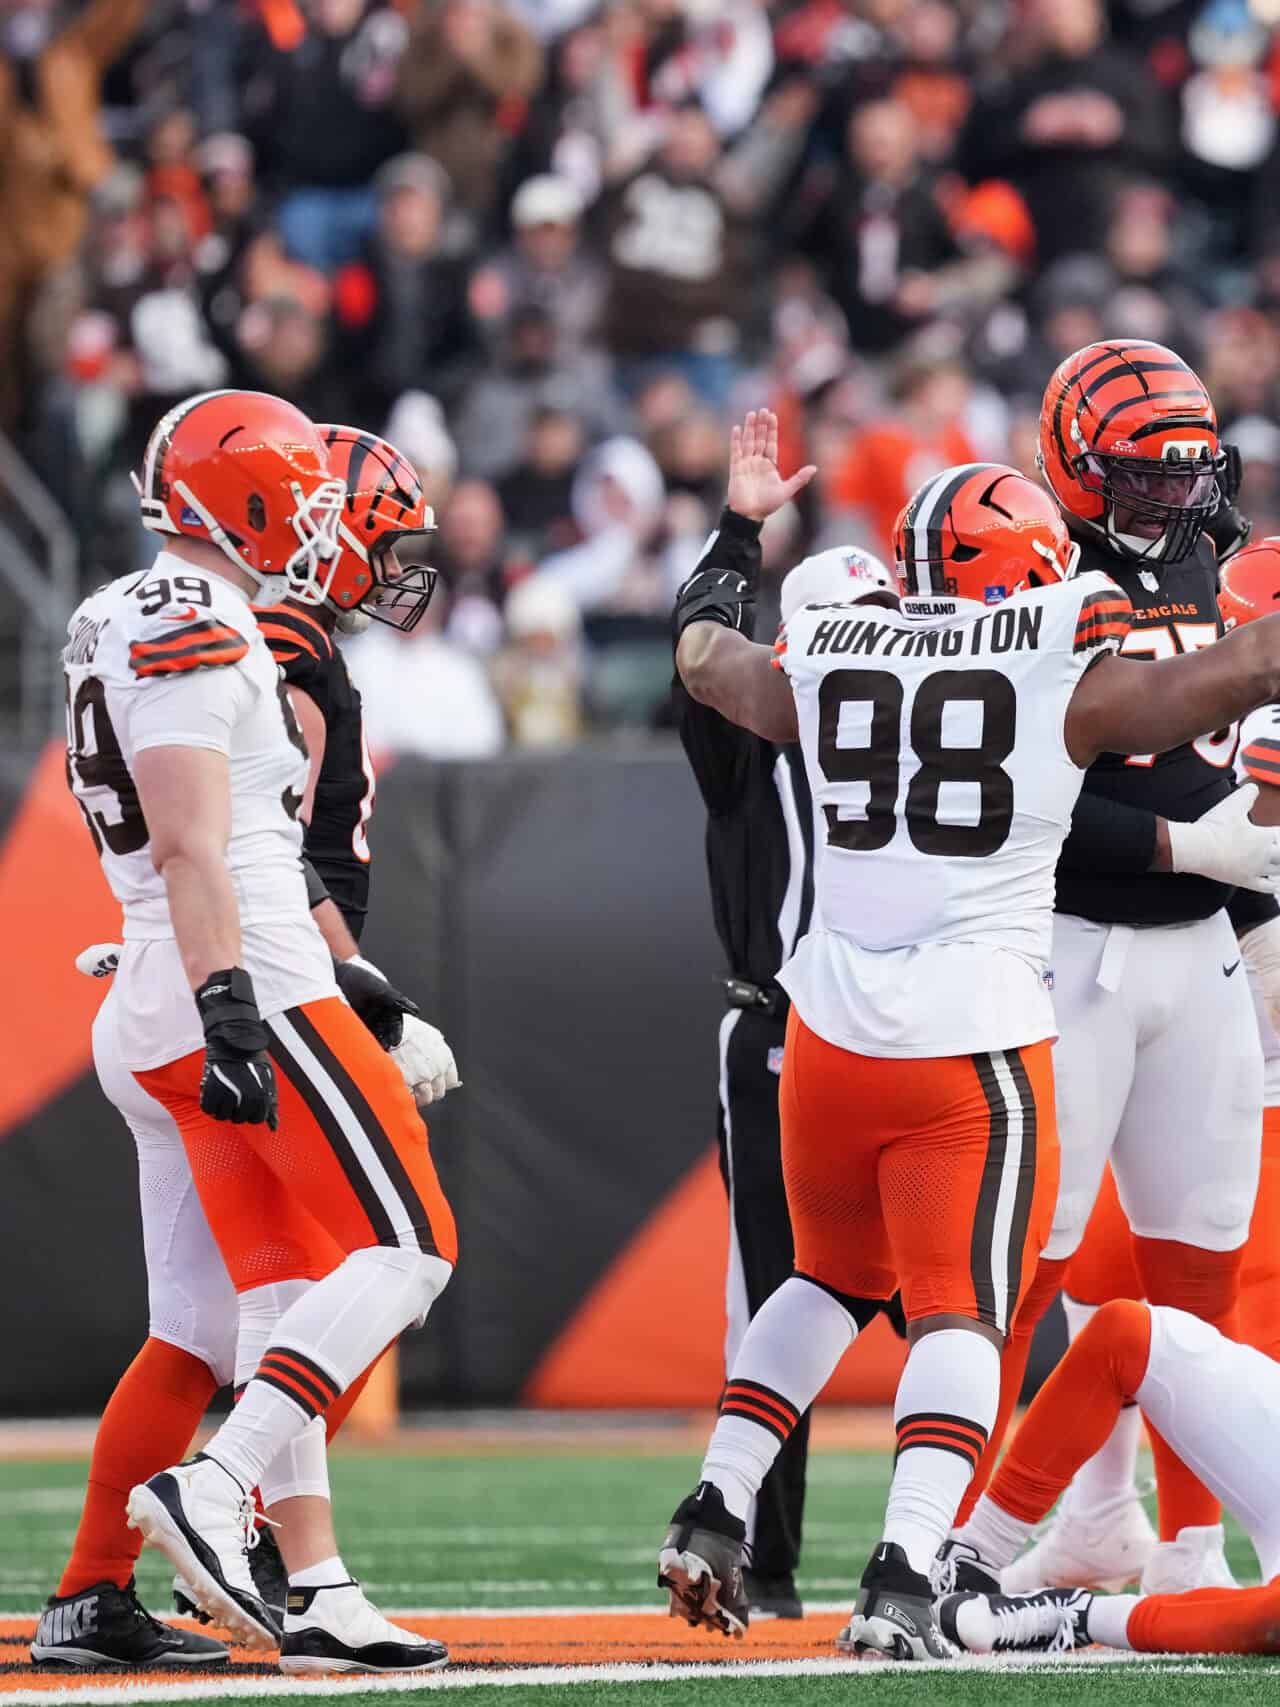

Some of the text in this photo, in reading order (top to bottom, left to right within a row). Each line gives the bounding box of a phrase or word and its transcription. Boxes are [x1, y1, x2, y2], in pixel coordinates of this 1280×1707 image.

[134, 576, 212, 616] 99
[904, 603, 956, 615] CLEVELAND
[1134, 603, 1199, 620] ENGALS
[806, 605, 1043, 657] HUNTINGTON
[817, 669, 1016, 857] 98
[38, 1594, 99, 1647] NIKE
